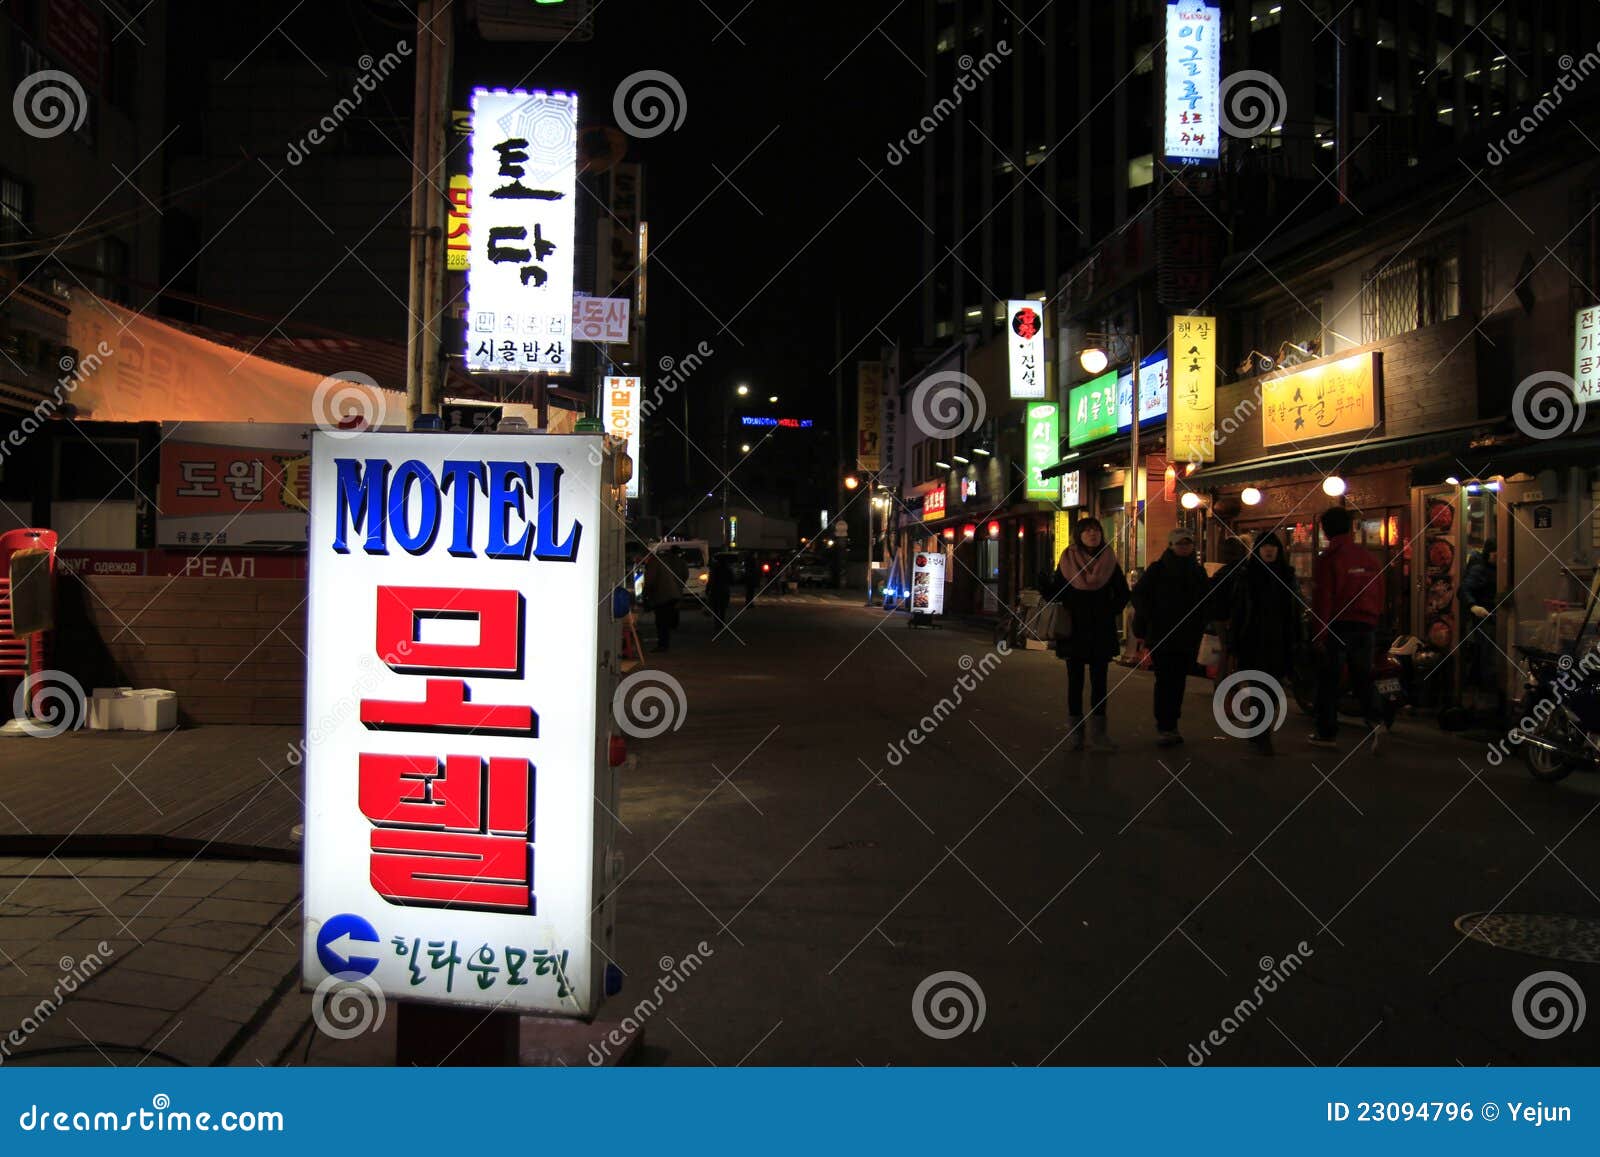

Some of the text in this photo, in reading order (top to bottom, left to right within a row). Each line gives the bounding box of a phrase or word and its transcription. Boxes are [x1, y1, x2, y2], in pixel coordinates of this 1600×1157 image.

[1178, 25, 1204, 110] 이글루
[487, 138, 566, 288] 토담
[475, 338, 565, 364] 시골밥상
[1178, 322, 1211, 340] 햇살
[1580, 311, 1594, 396] 전기공사
[1076, 383, 1117, 424] 시골집
[176, 460, 264, 501] 도원
[332, 458, 584, 563] MOTEL
[176, 531, 227, 544] 유흥주점
[185, 556, 256, 578] РЕАЛ
[358, 585, 540, 916] 모텔
[391, 935, 576, 999] 힐타운모텔
